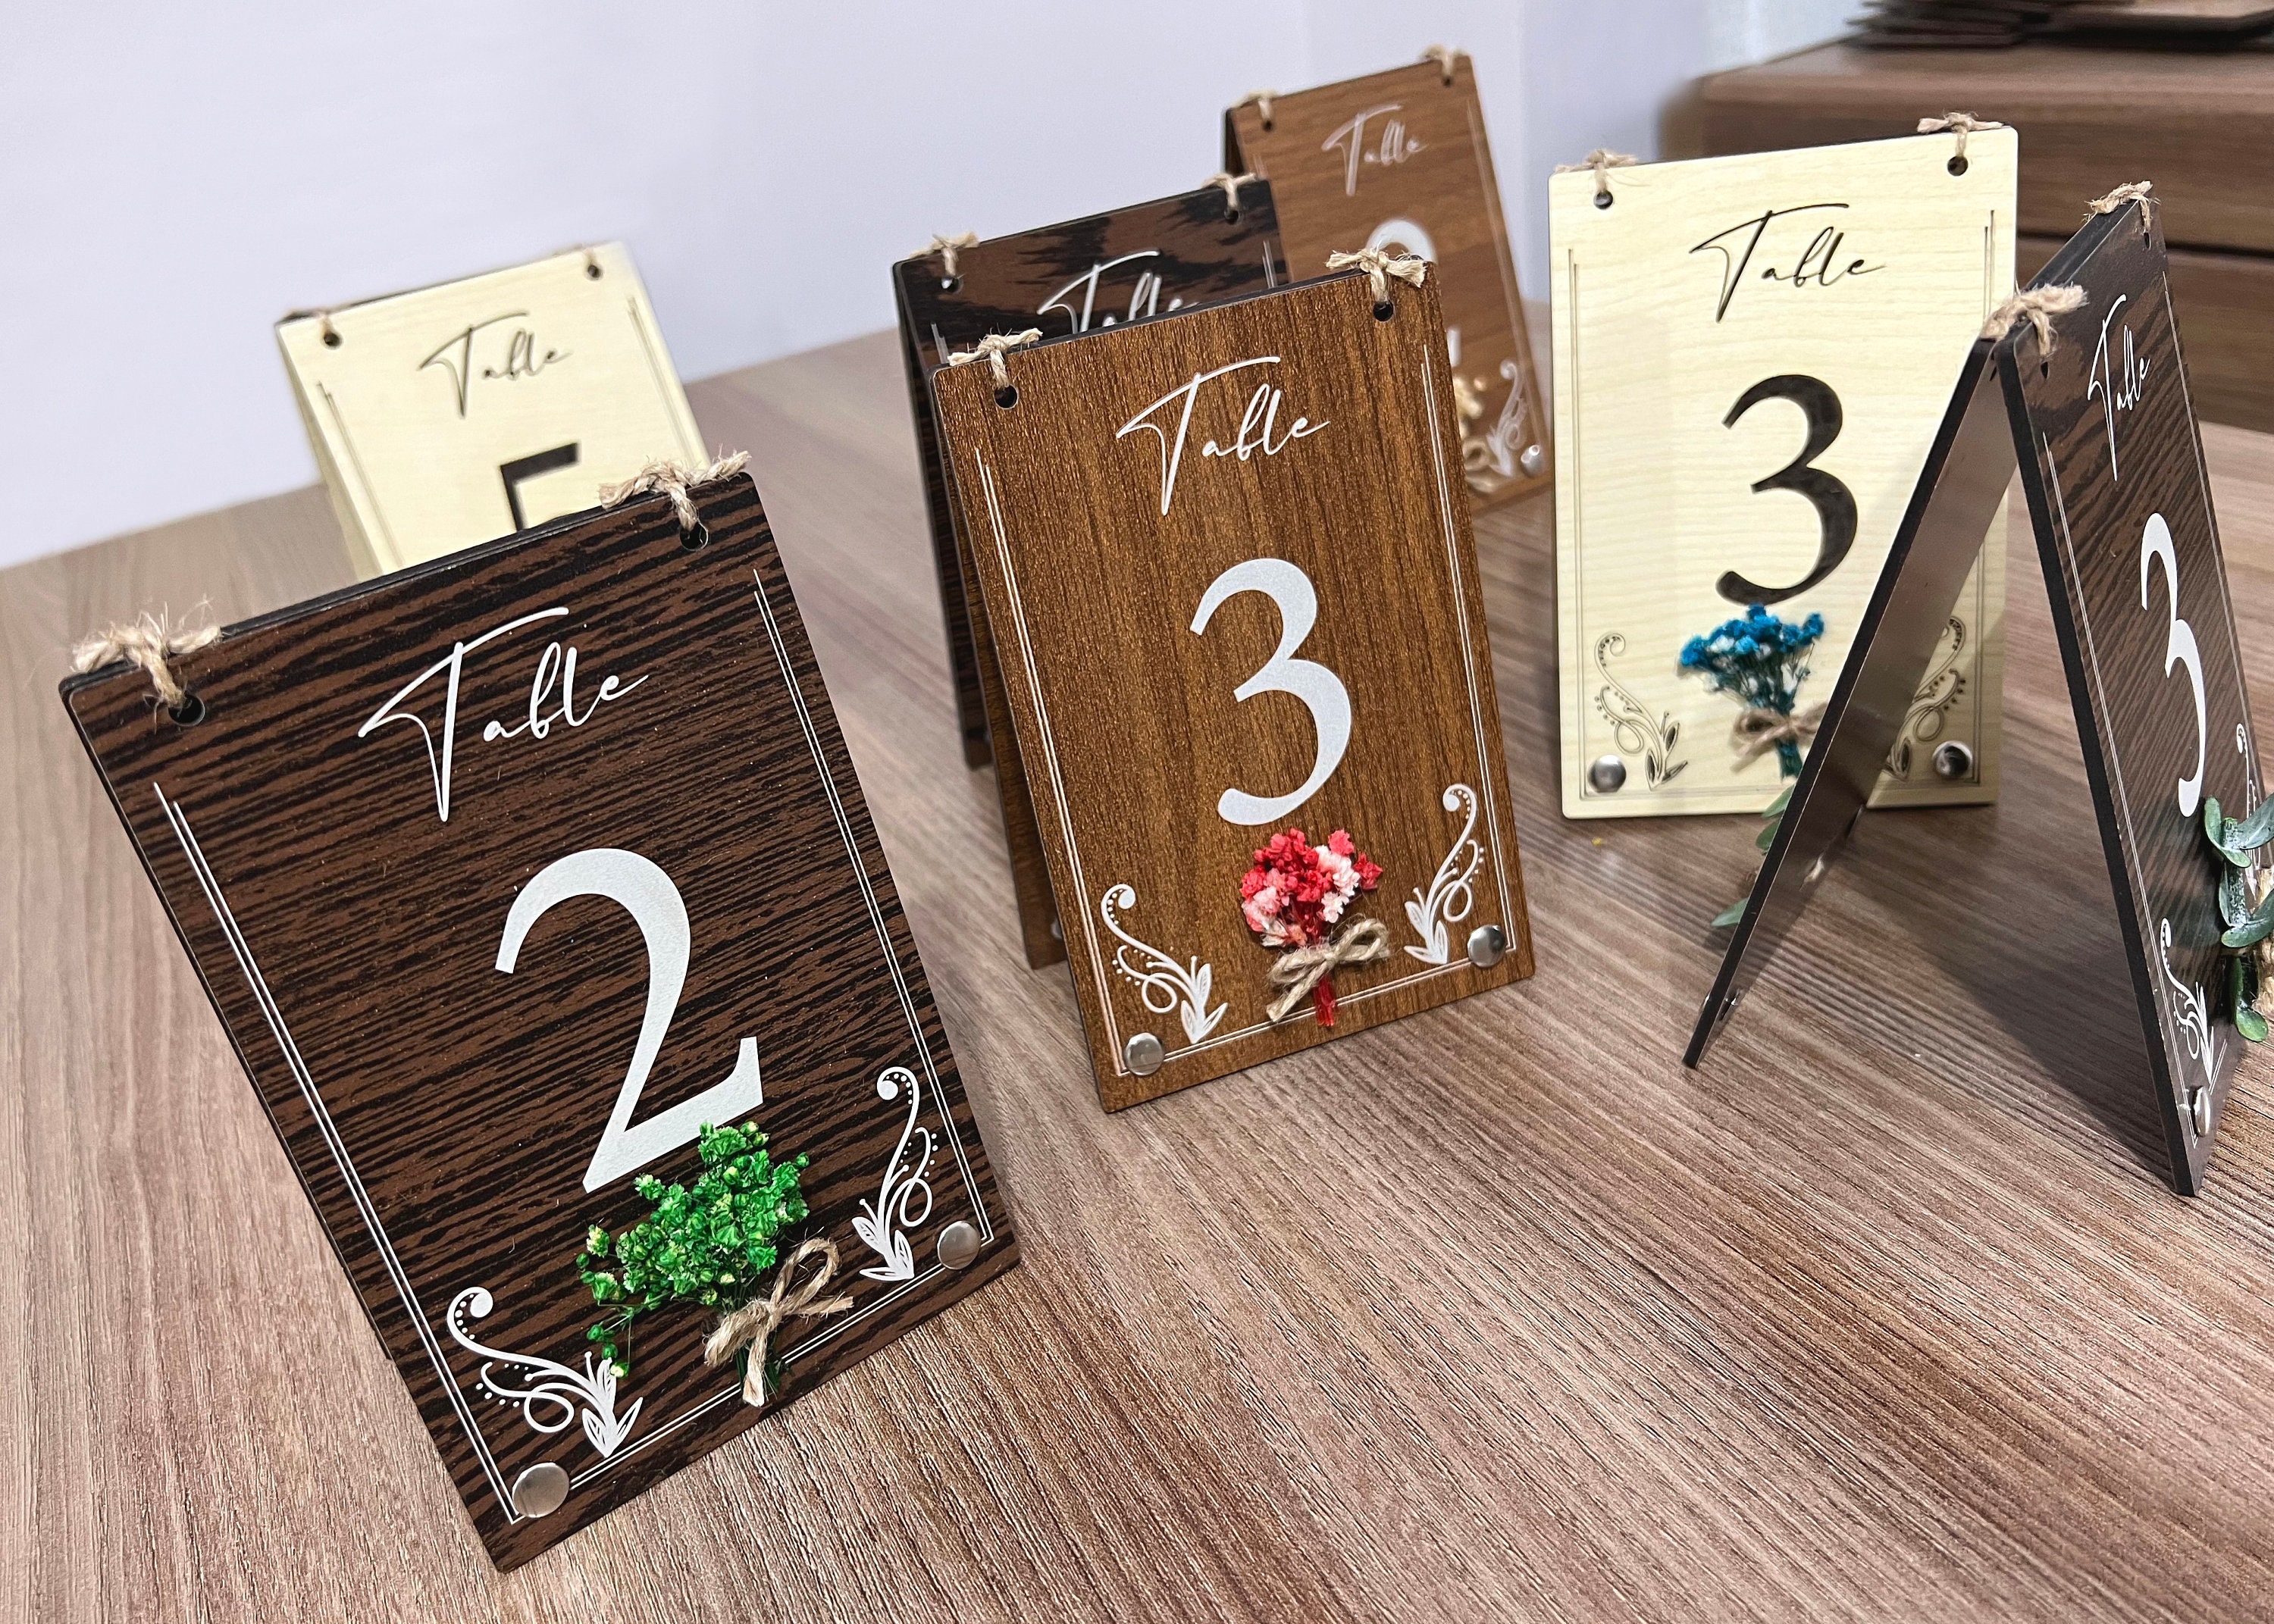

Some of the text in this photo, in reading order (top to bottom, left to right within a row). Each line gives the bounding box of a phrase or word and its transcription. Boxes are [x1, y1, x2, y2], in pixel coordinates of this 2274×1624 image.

[1321, 104, 1429, 196] Table
[1688, 202, 1887, 324] Table
[415, 309, 574, 419] Table
[1116, 356, 1330, 516] Table
[2087, 293, 2150, 481] Table
[1715, 374, 1859, 605] 3
[358, 607, 649, 821] Table
[1189, 558, 1352, 825] 3
[2141, 512, 2207, 818] 3
[495, 847, 763, 1193] 2
